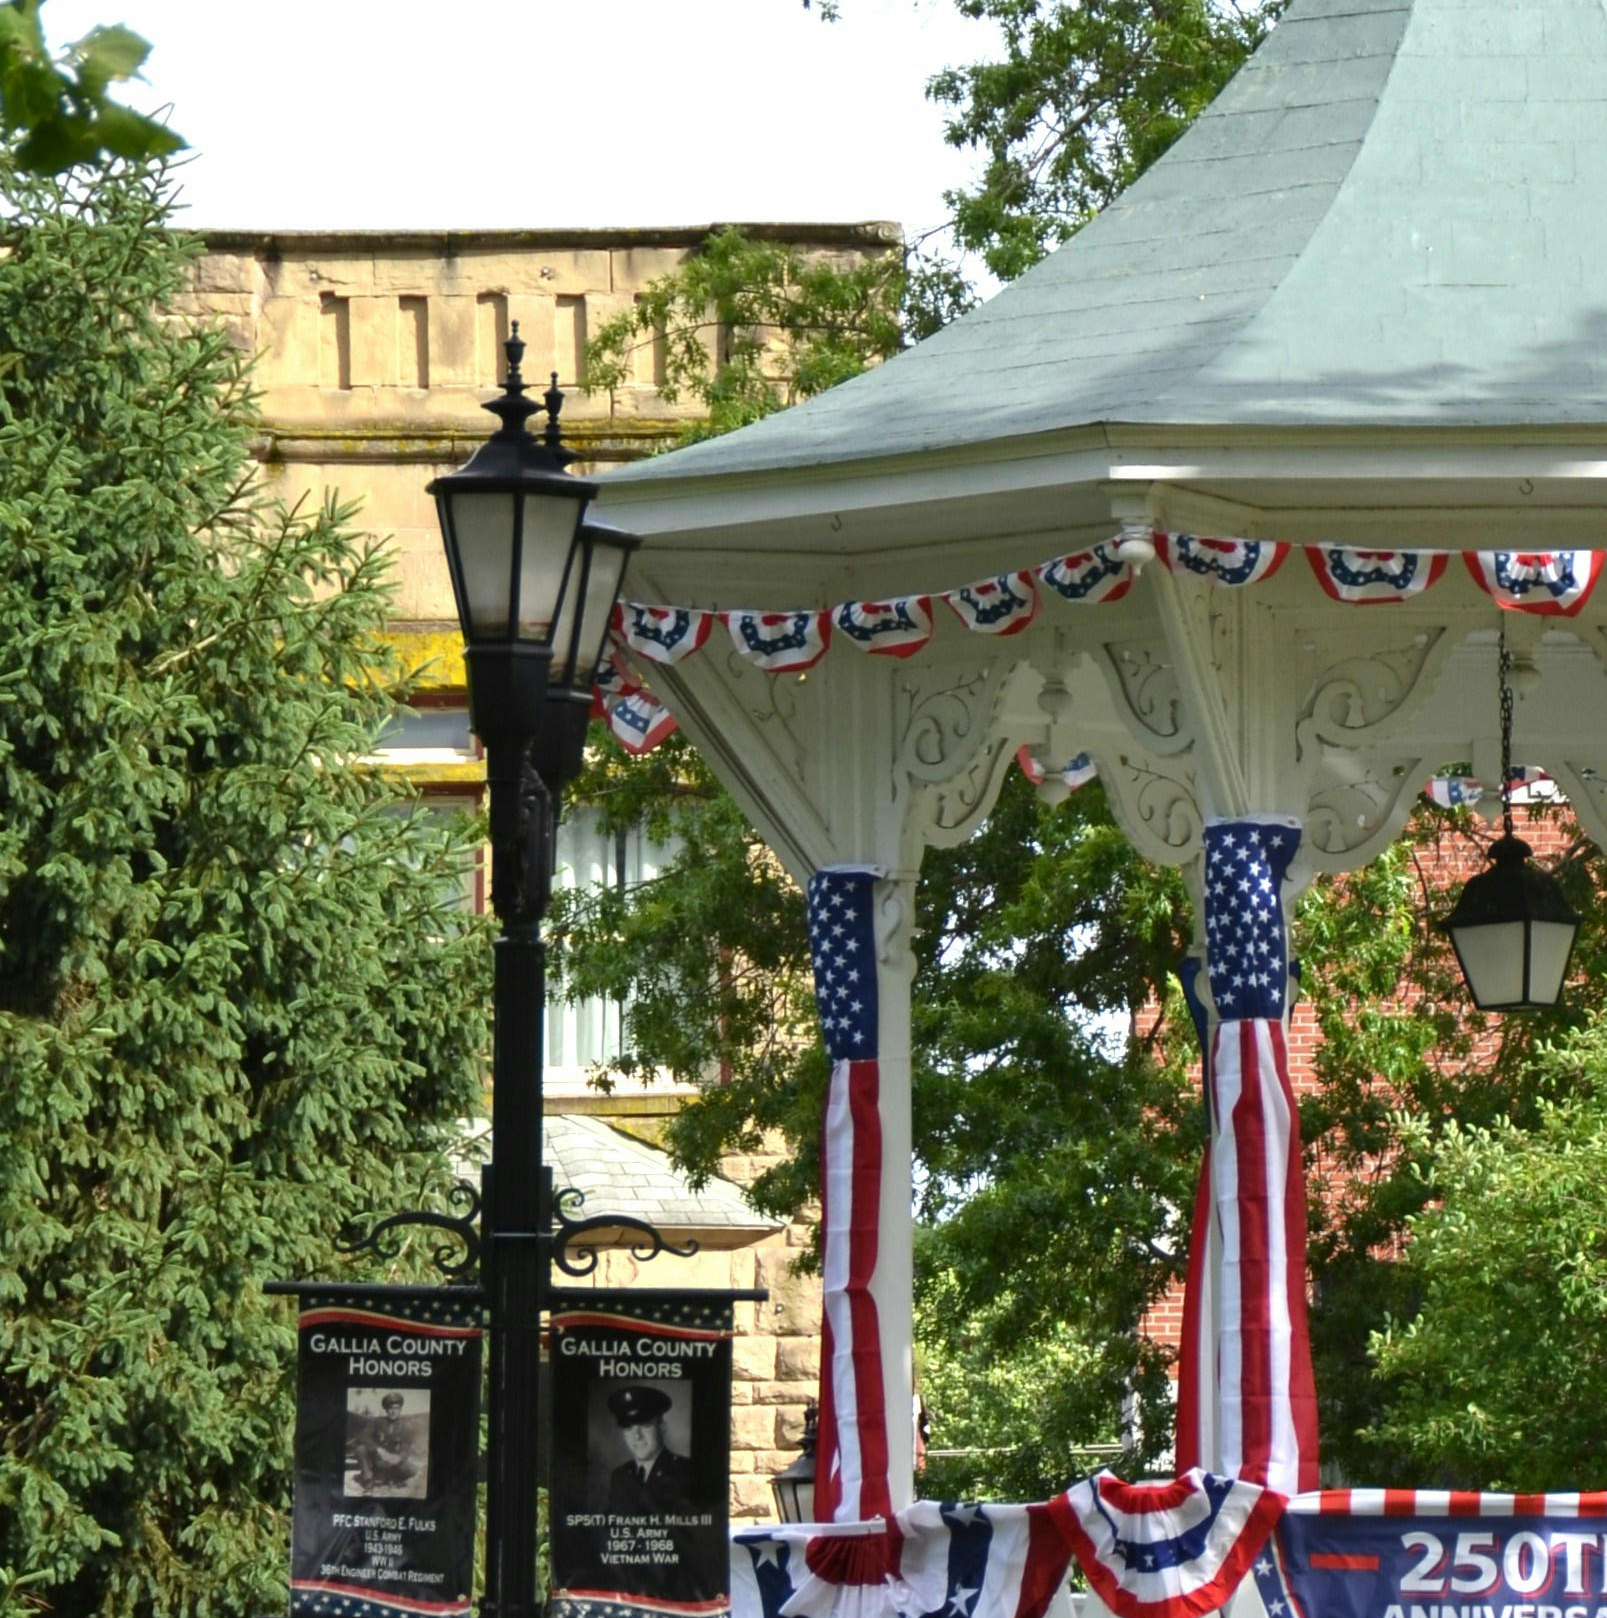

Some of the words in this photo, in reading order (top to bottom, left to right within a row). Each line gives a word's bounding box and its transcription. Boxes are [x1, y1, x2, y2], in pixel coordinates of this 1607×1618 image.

[310, 1334, 381, 1353] GALLIA
[386, 1335, 467, 1355] COUNTY
[561, 1337, 631, 1356] GALLIA
[636, 1338, 717, 1357] COUNTY
[349, 1356, 432, 1376] HONORS
[600, 1359, 682, 1378] HONORS
[332, 1514, 352, 1527] PFC
[353, 1515, 397, 1529] STANFORD
[408, 1517, 436, 1532] FULKS
[566, 1514, 606, 1526] SP5(T)
[608, 1515, 647, 1526] FRANK
[650, 1515, 662, 1526] H.
[665, 1515, 699, 1526] MILLS
[700, 1515, 712, 1526] III
[381, 1531, 402, 1542] ARMY
[610, 1528, 634, 1538] U.S.
[636, 1528, 668, 1538] ARMY
[601, 1553, 650, 1564] VIETNAM
[652, 1553, 679, 1563] WAR
[341, 1565, 376, 1579] ENGINEER
[377, 1568, 407, 1580] COMBAT
[407, 1570, 444, 1583] REGIMENT
